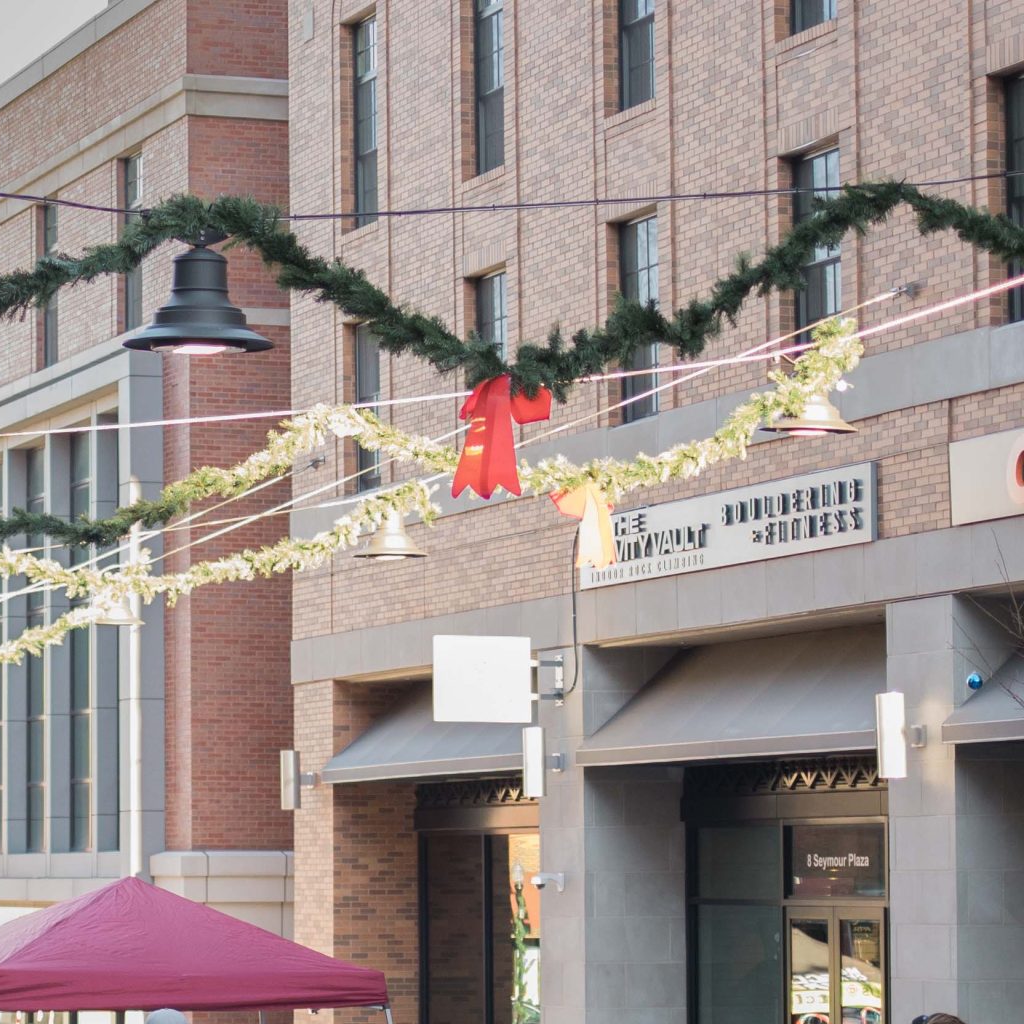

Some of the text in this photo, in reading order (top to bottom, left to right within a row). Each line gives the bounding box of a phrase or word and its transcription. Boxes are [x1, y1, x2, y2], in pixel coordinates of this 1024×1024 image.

[721, 478, 863, 526] BOULDERING
[612, 512, 647, 537] THE
[614, 522, 710, 563] VITY VAULT
[590, 553, 705, 583] INDOOR ROCK CLIMBING
[807, 853, 870, 870] 8 Seymour Plaza
